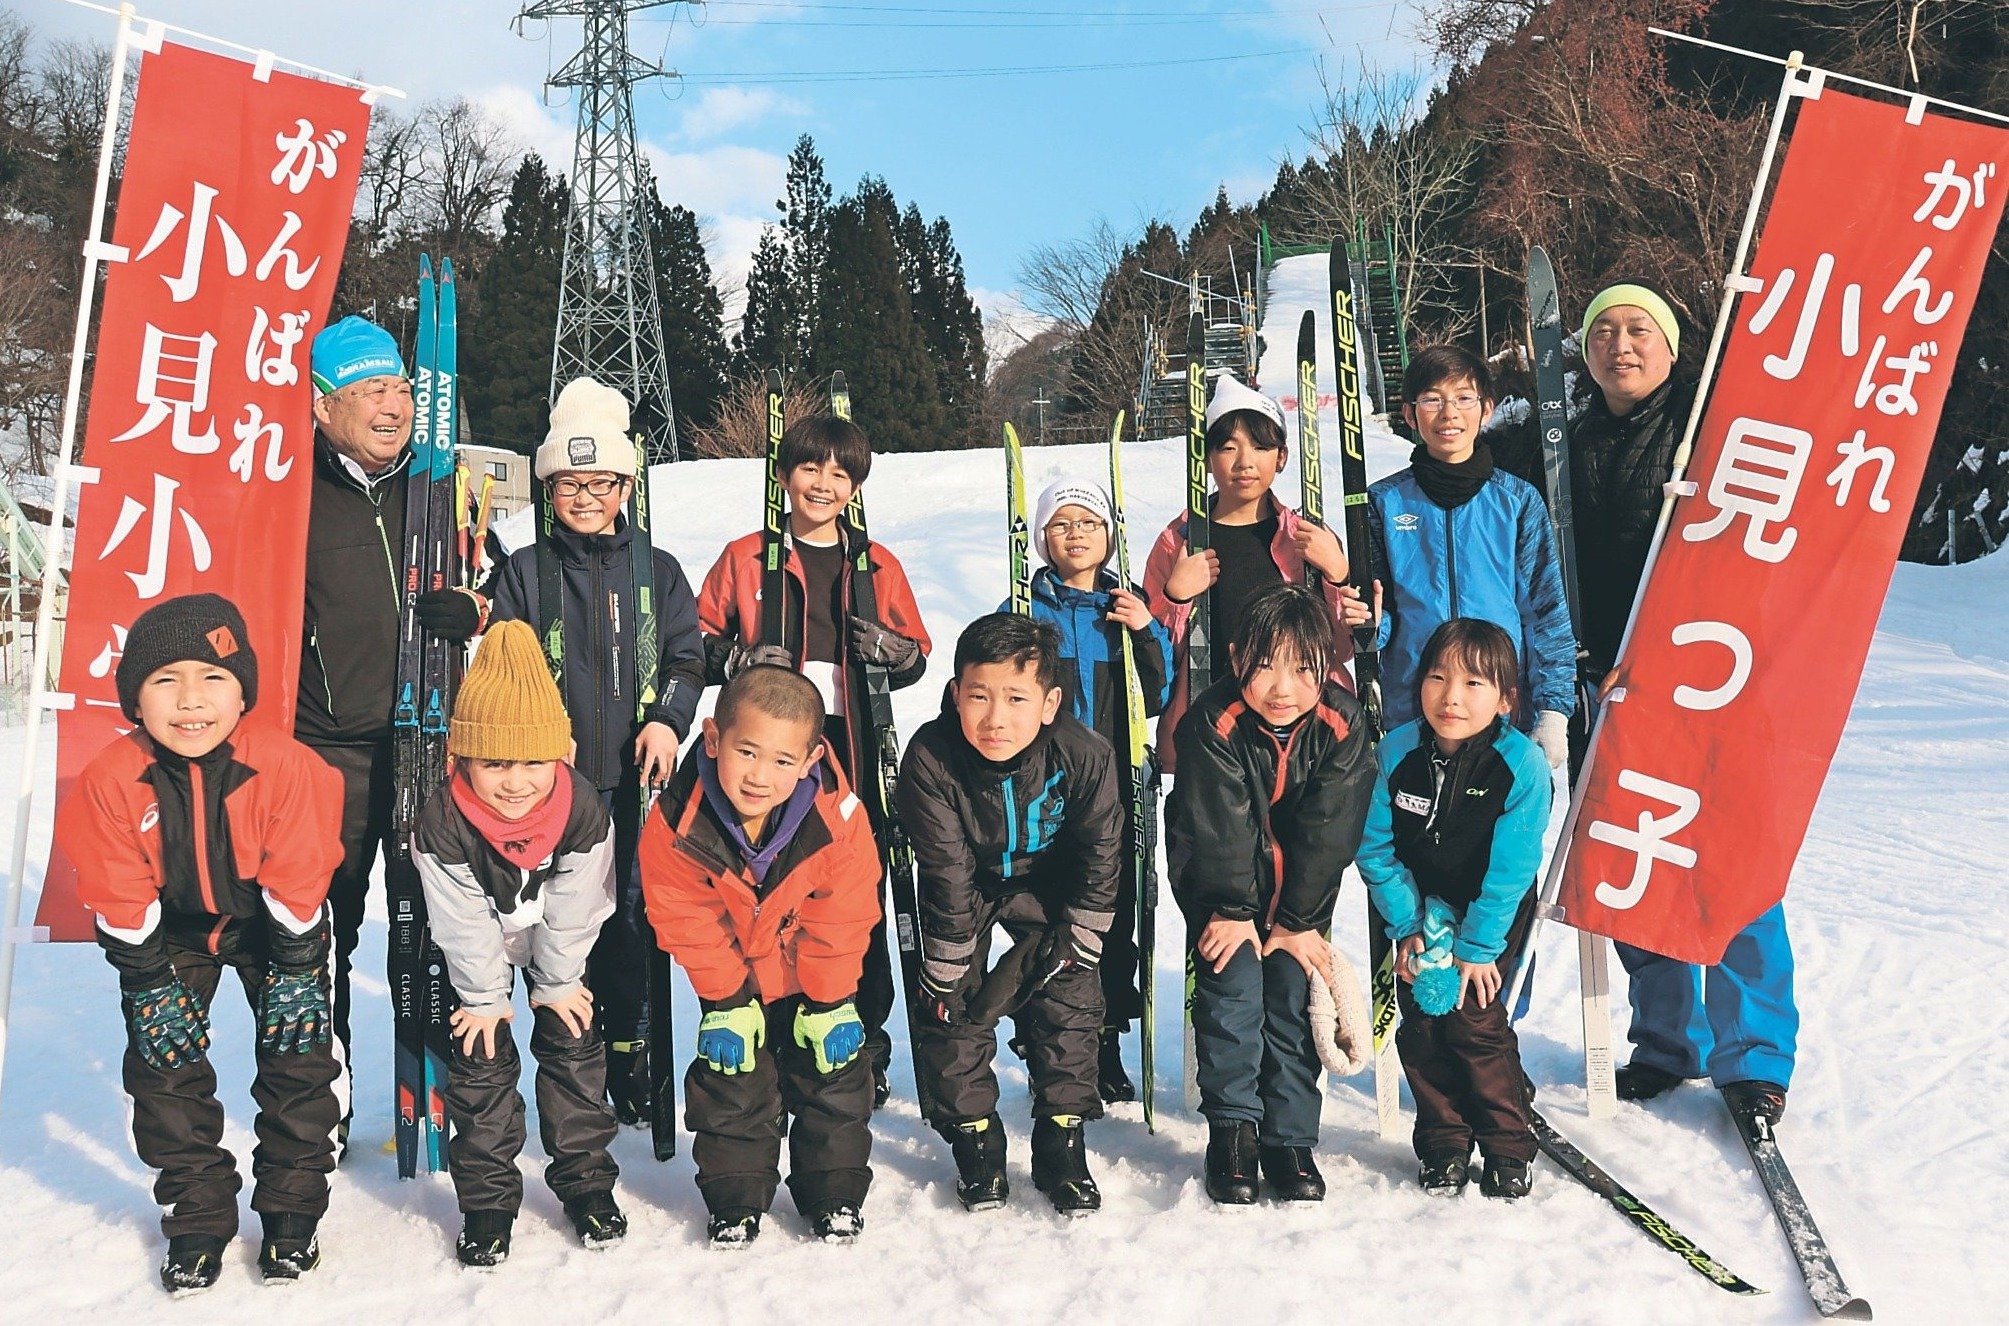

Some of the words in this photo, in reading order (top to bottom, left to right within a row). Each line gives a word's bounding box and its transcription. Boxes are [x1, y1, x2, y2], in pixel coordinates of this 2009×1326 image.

[229, 119, 347, 482] がんばれ
[1826, 159, 1996, 512] がんばれ
[414, 366, 433, 445] ATOMIC
[436, 371, 453, 450] ATOMIC
[1336, 289, 1362, 460] FISCHER
[1190, 362, 1206, 518] FISCHER
[1301, 360, 1322, 519] FISCHER
[634, 433, 648, 533] FISCHER
[407, 592, 417, 606] C2
[408, 566, 418, 591] PRO
[1589, 253, 1861, 910] 小見つ子
[1131, 765, 1145, 861] FISCHER
[401, 924, 410, 944] 188
[401, 974, 411, 1018] CLASSIC
[430, 980, 440, 1024] CLASSIC
[402, 1106, 413, 1126] C2
[431, 1113, 443, 1132] C2
